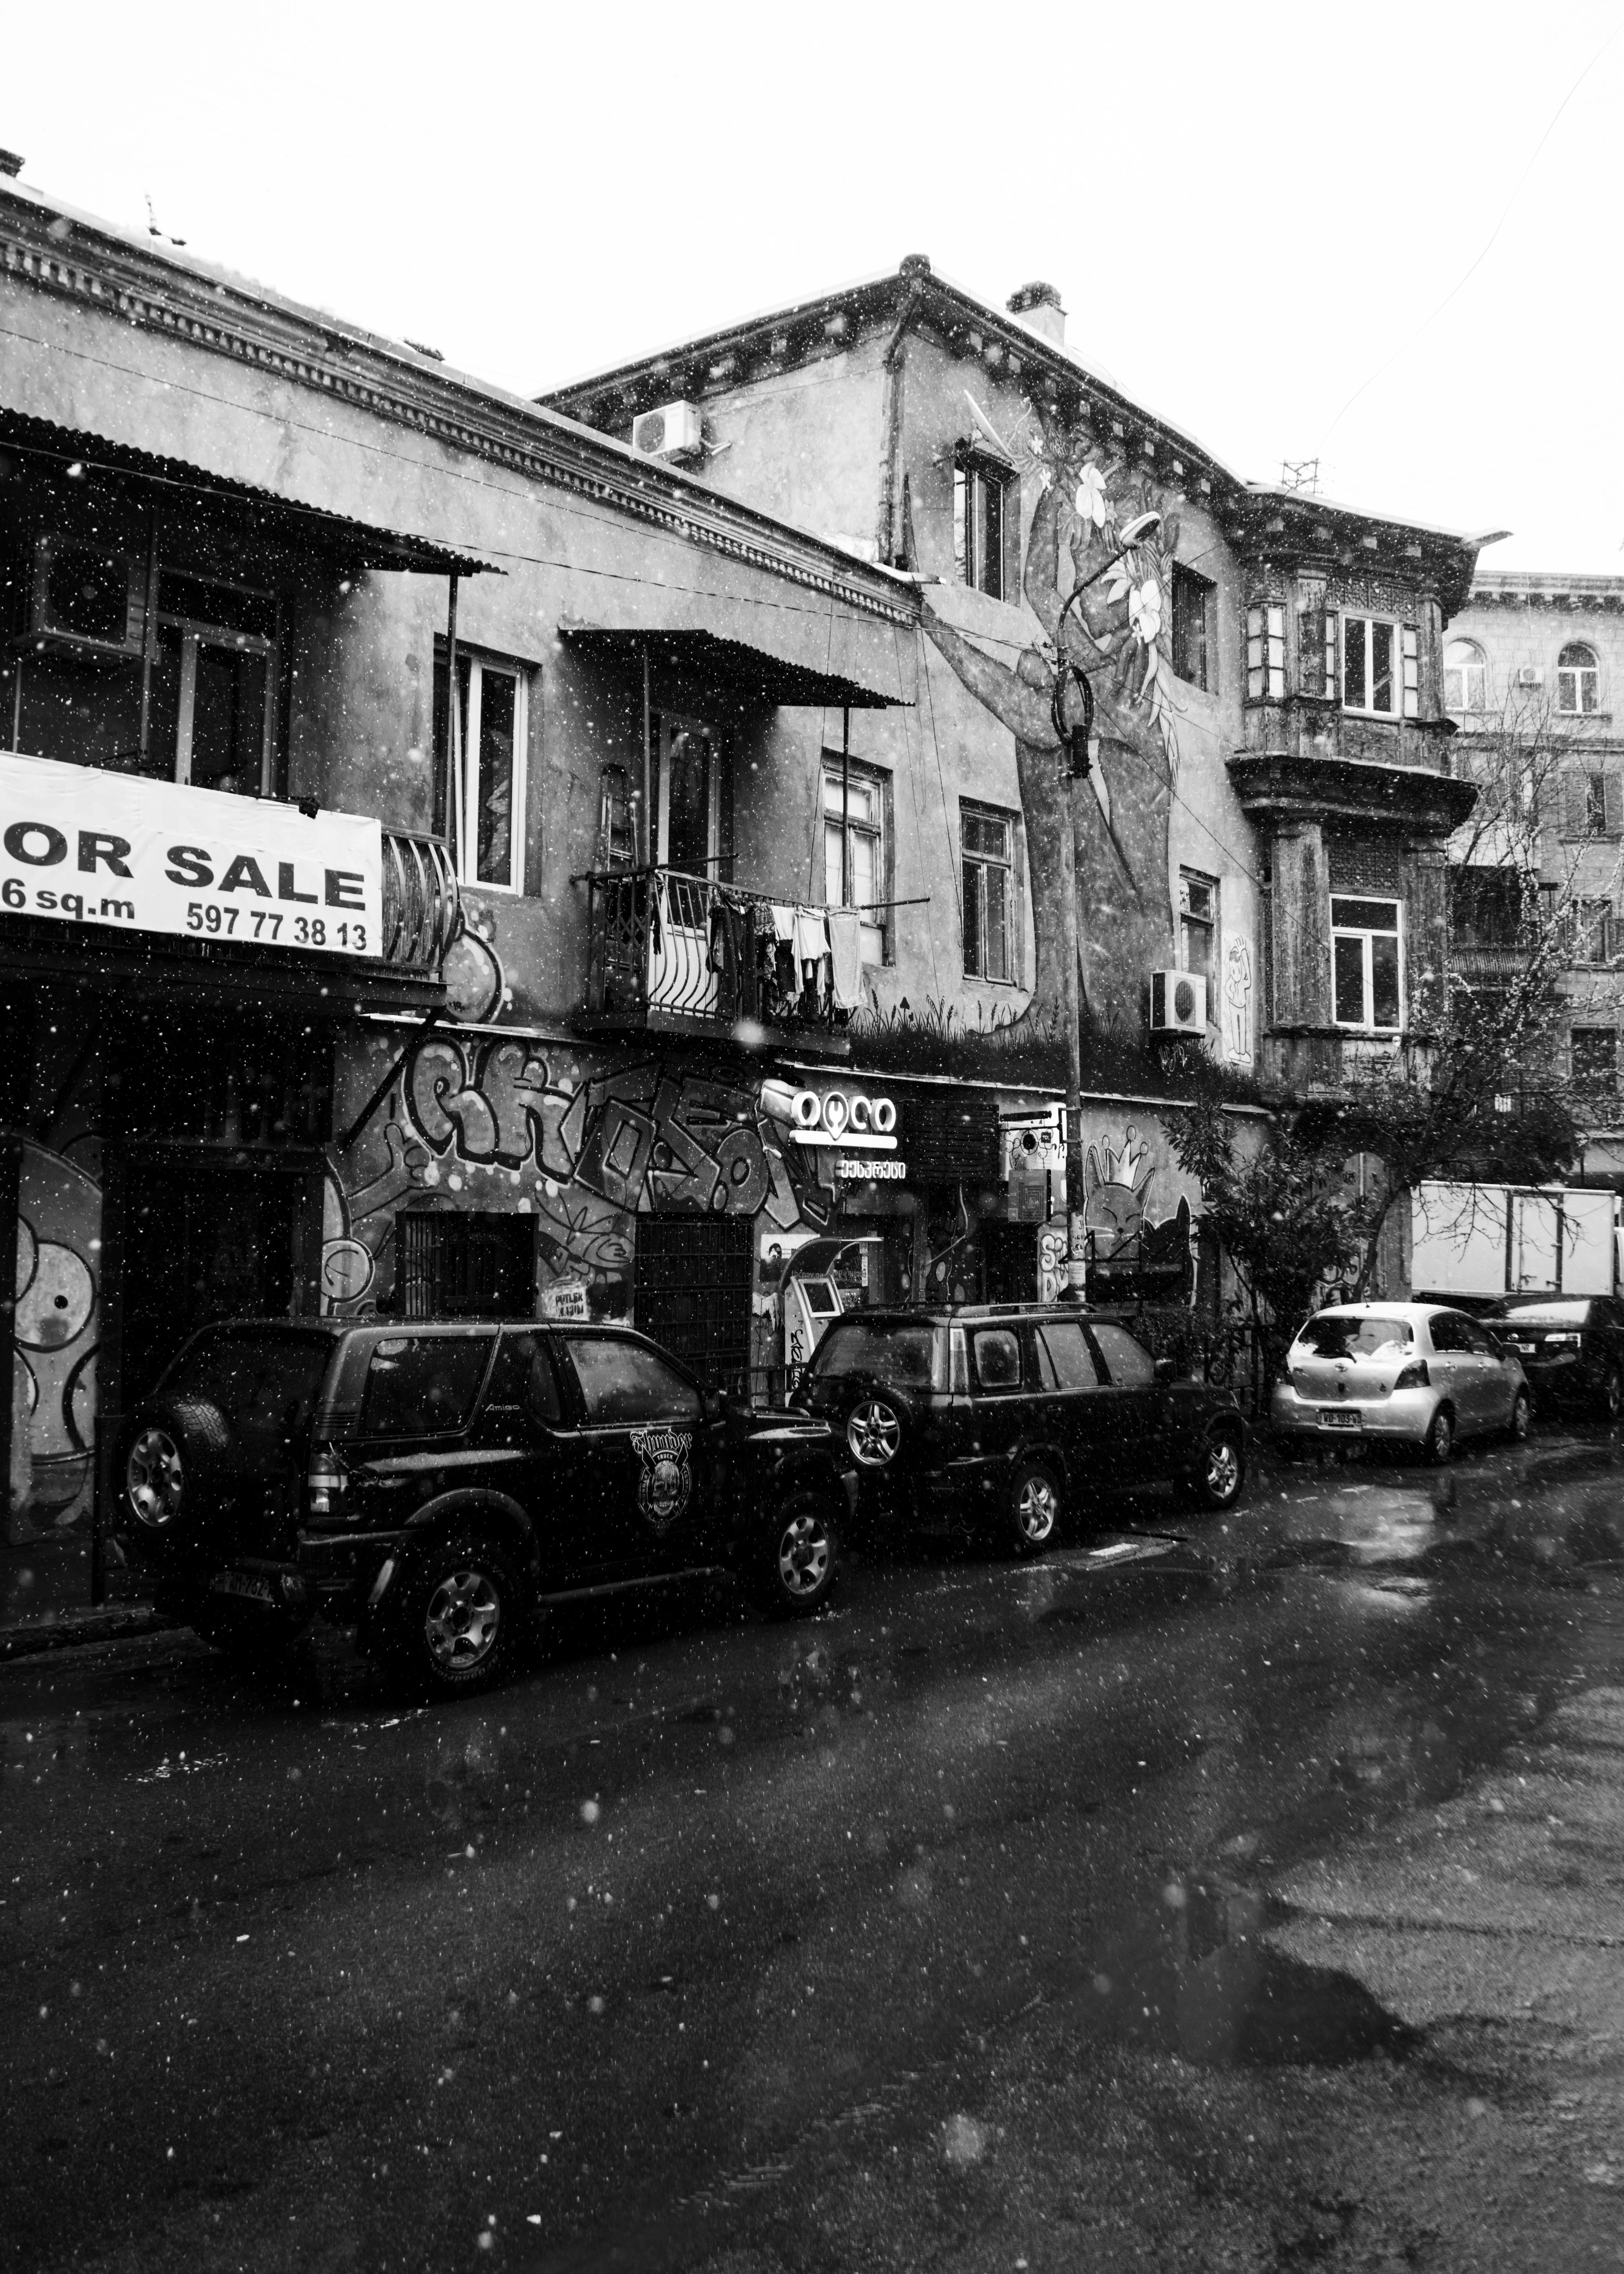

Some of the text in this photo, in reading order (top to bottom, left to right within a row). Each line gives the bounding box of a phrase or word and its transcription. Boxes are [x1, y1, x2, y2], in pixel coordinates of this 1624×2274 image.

[164, 845, 366, 911] SALE
[36, 890, 135, 920] sq.m
[187, 902, 240, 935] 597
[250, 910, 284, 940] 77
[294, 916, 327, 945] 38
[337, 922, 367, 951] 13
